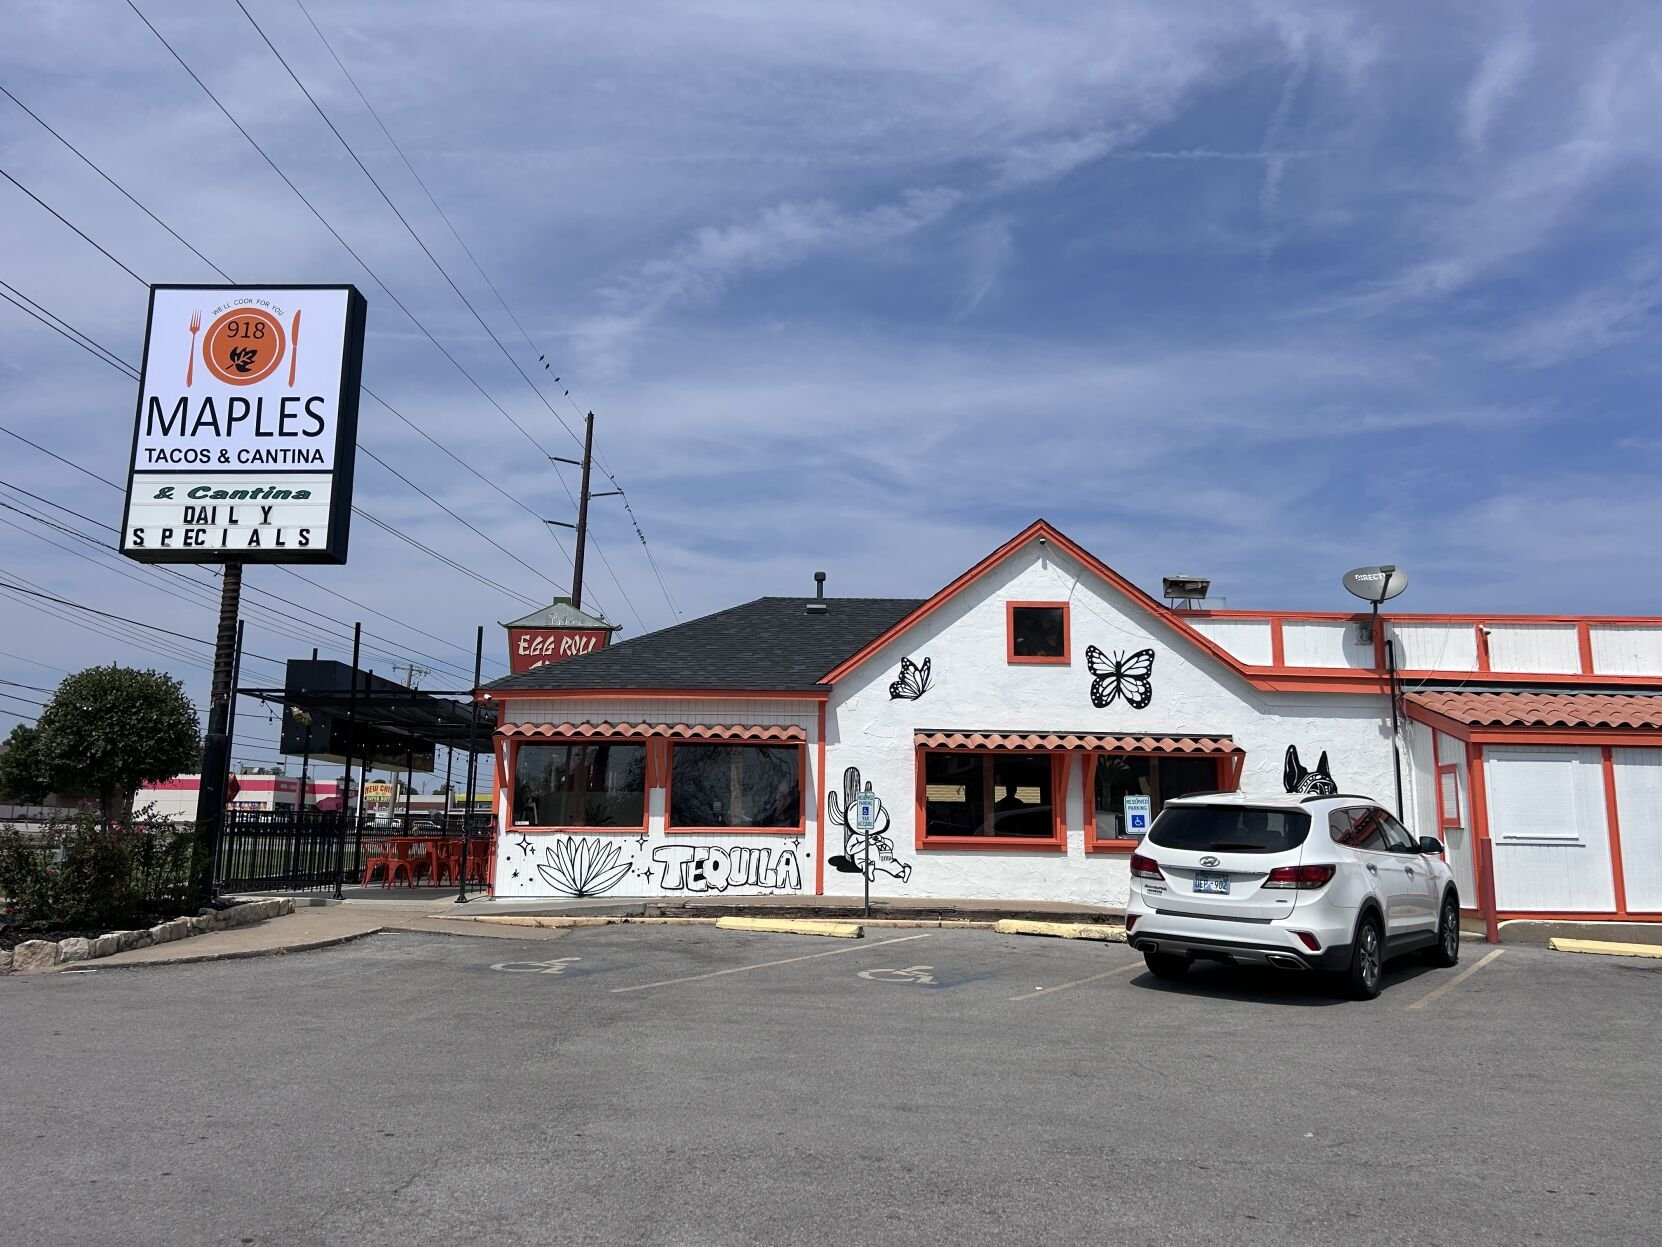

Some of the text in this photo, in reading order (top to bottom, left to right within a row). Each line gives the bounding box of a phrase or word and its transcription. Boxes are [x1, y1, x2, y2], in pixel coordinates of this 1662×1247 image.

[234, 298, 253, 306] COOK
[256, 298, 270, 308] FOR
[272, 306, 284, 316] YOU
[227, 321, 265, 339] 918
[146, 396, 325, 437] MAPLES
[144, 448, 325, 464] TACOS & CANTINA
[153, 485, 312, 500] & Cantina
[518, 635, 555, 656] EGG
[365, 785, 379, 796] NEW
[652, 845, 801, 892] TEQUILA
